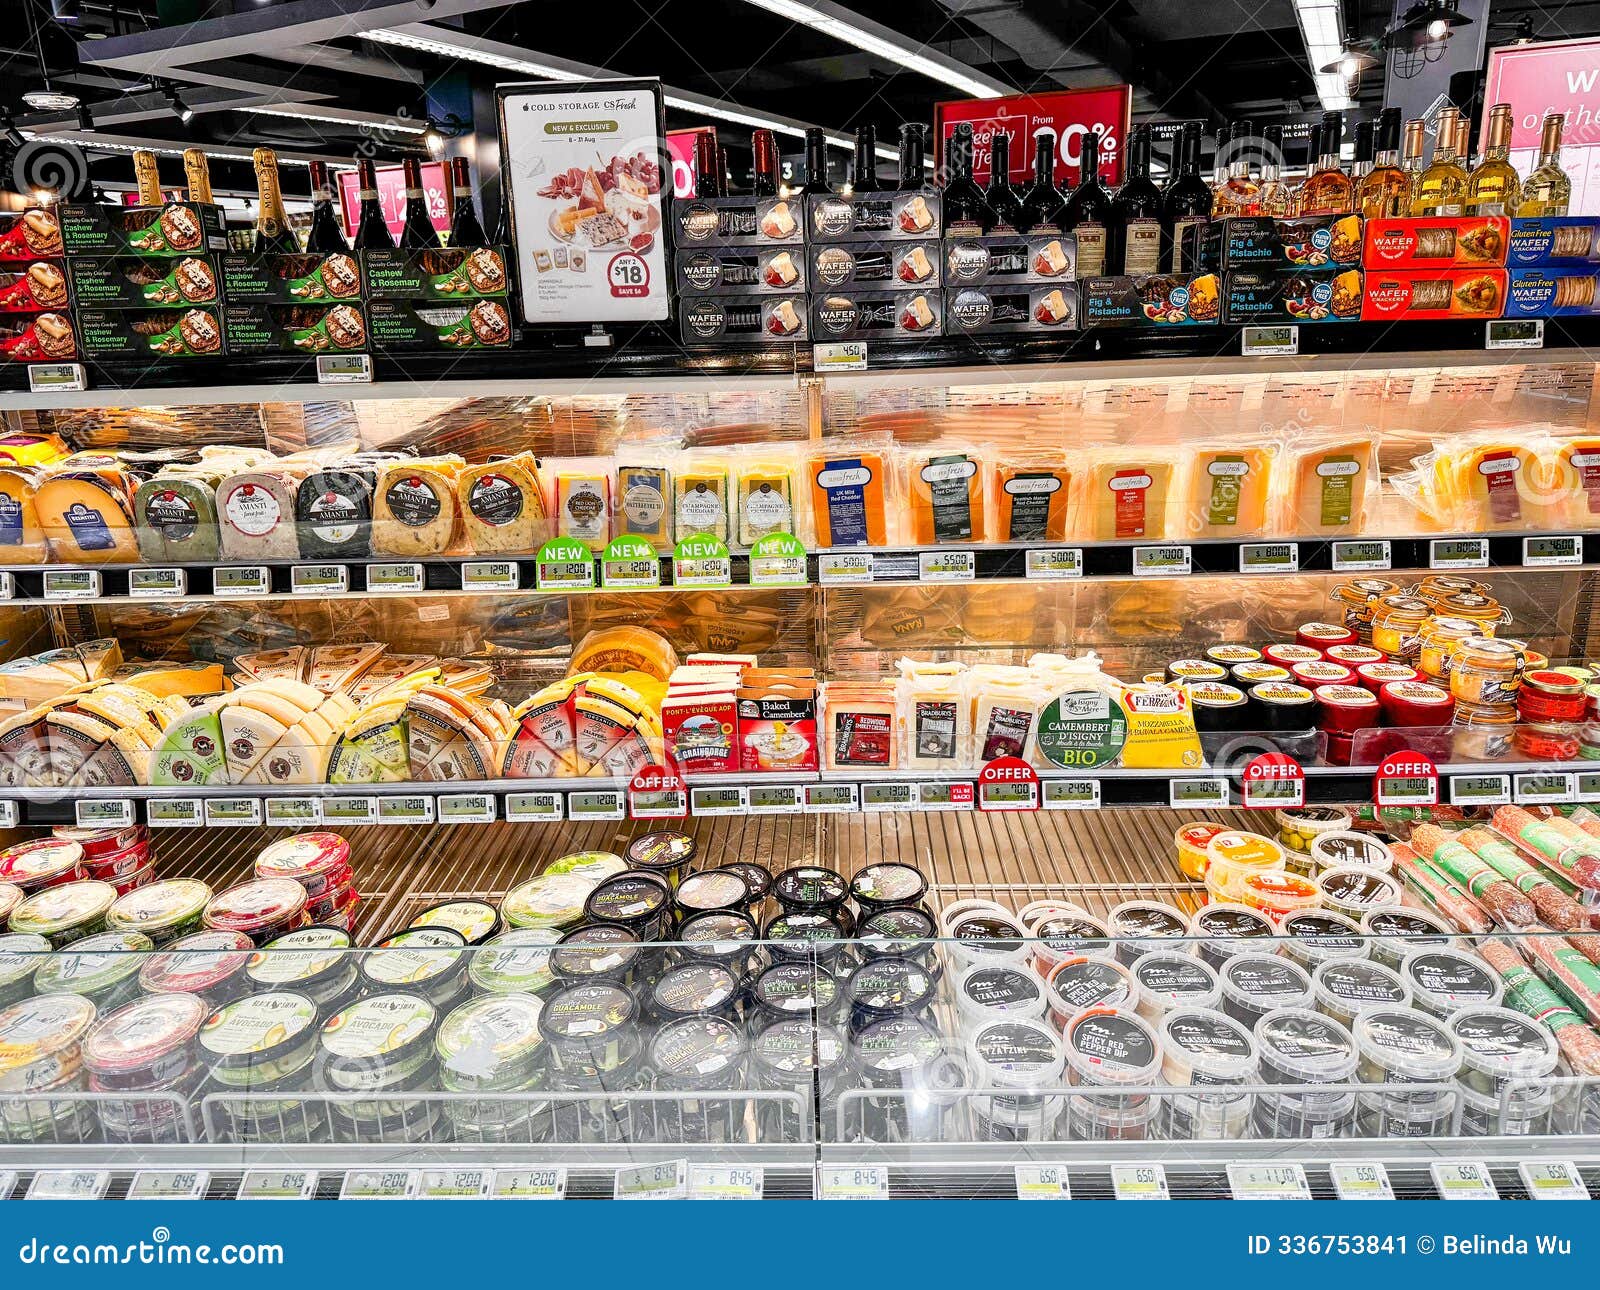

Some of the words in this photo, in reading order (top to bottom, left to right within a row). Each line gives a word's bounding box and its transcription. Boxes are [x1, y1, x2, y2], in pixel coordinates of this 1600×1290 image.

[531, 104, 555, 112] COLD
[558, 102, 600, 110] STORAGE
[1032, 116, 1054, 125] From
[576, 123, 610, 132] EXCLUSIVE
[584, 136, 596, 144] Aug
[430, 209, 447, 219] OFF
[815, 212, 852, 220] WAFER
[680, 216, 718, 226] WAFER
[64, 224, 92, 232] Cashew
[72, 232, 108, 241] Rosemary
[1510, 230, 1535, 238] Gluten
[1230, 239, 1244, 248] Fig
[1374, 238, 1414, 246] WAFER
[1510, 238, 1550, 247] WAFER
[1230, 249, 1272, 258] Pistachio
[950, 254, 988, 264] WAFER
[683, 266, 720, 275] WAFER
[816, 262, 852, 271] WAFER
[369, 269, 403, 278] Cashew
[615, 266, 642, 284] $18
[233, 280, 268, 288] Rosemary
[378, 278, 420, 288] Rosemary
[1512, 280, 1536, 288] Gluten
[84, 284, 121, 294] Rosemary
[1369, 290, 1408, 298] WAFER
[1512, 288, 1552, 298] WAFER
[1089, 298, 1104, 308] Fig
[1232, 293, 1246, 303] Fig
[953, 304, 990, 314] WAFER
[1088, 306, 1131, 316] Pistachio
[1230, 302, 1273, 312] Pistachio
[687, 314, 724, 324] WAFER
[819, 310, 856, 320] WAFER
[84, 328, 112, 336] Cashew
[227, 324, 256, 332] Cashew
[380, 326, 416, 335] Rosemary
[92, 336, 127, 344] Rosemary
[235, 331, 272, 339] Rosemary
[398, 492, 428, 505] AMANTI
[480, 490, 509, 504] AMANTI
[841, 494, 861, 502] Cheddar
[319, 510, 349, 519] AMANTI
[611, 544, 649, 558] NEW
[682, 544, 719, 556] NEW
[759, 542, 797, 554] NEW
[545, 547, 583, 560] NEW
[762, 702, 790, 710] Baked
[762, 710, 806, 719] Camembert
[586, 714, 614, 727] ORGANIC
[860, 716, 886, 725] REDWOOD
[1048, 722, 1110, 732] CAMEMBERT
[1058, 732, 1104, 740] D'ISIGNY
[1063, 749, 1097, 765] BIO
[984, 767, 1032, 780] OFFER
[1250, 765, 1298, 776] OFFER
[1383, 763, 1431, 775] OFFER
[634, 776, 680, 788] OFFER
[596, 894, 638, 902] GUACAMOLE
[271, 952, 312, 962] AVOCADO
[1146, 977, 1176, 985] CLASSIC
[1176, 976, 1208, 984] HUMMUS
[1066, 986, 1085, 1000] SPICY
[1086, 980, 1100, 991] RED
[1356, 984, 1386, 992] STUFFED
[574, 990, 590, 998] BLACK
[974, 988, 1012, 1000] TZATZIKI
[1073, 989, 1100, 1006] PEPPER
[370, 1000, 389, 1010] BLACK
[553, 1004, 602, 1012] GUACAMOLE
[229, 1018, 274, 1028] AVOCADO
[350, 1020, 394, 1030] AVOCADO
[1082, 1033, 1108, 1046] SPICY
[1108, 1040, 1124, 1050] RED
[1178, 1036, 1210, 1046] CLASSIC
[985, 1046, 1026, 1056] TZATZIKI
[1080, 1040, 1112, 1054] PEPPER
[1114, 1047, 1129, 1058] DIP
